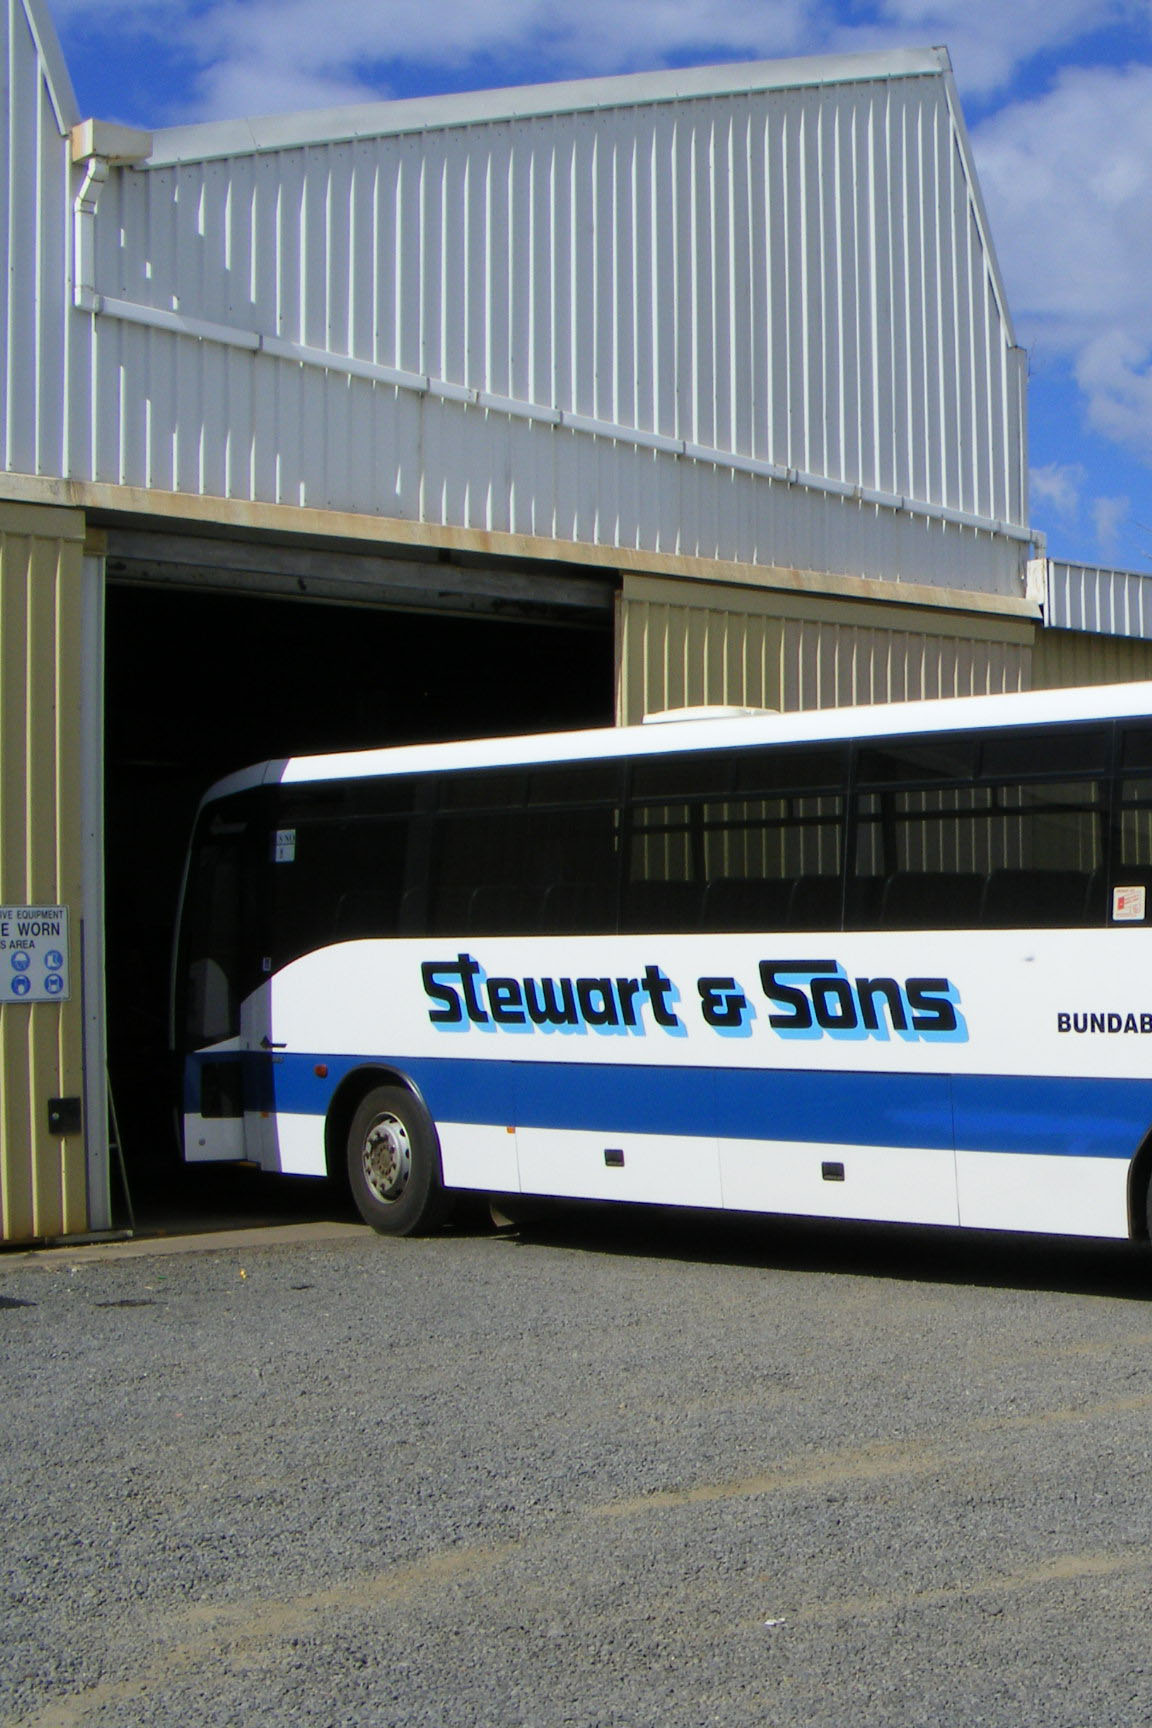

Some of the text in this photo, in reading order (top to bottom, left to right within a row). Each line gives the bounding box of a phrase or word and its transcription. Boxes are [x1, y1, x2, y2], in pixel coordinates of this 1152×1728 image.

[17, 910, 63, 919] EQUIPMENT
[18, 922, 60, 937] WORN
[9, 940, 35, 949] AREA
[421, 953, 969, 1042] Stewart & Sons
